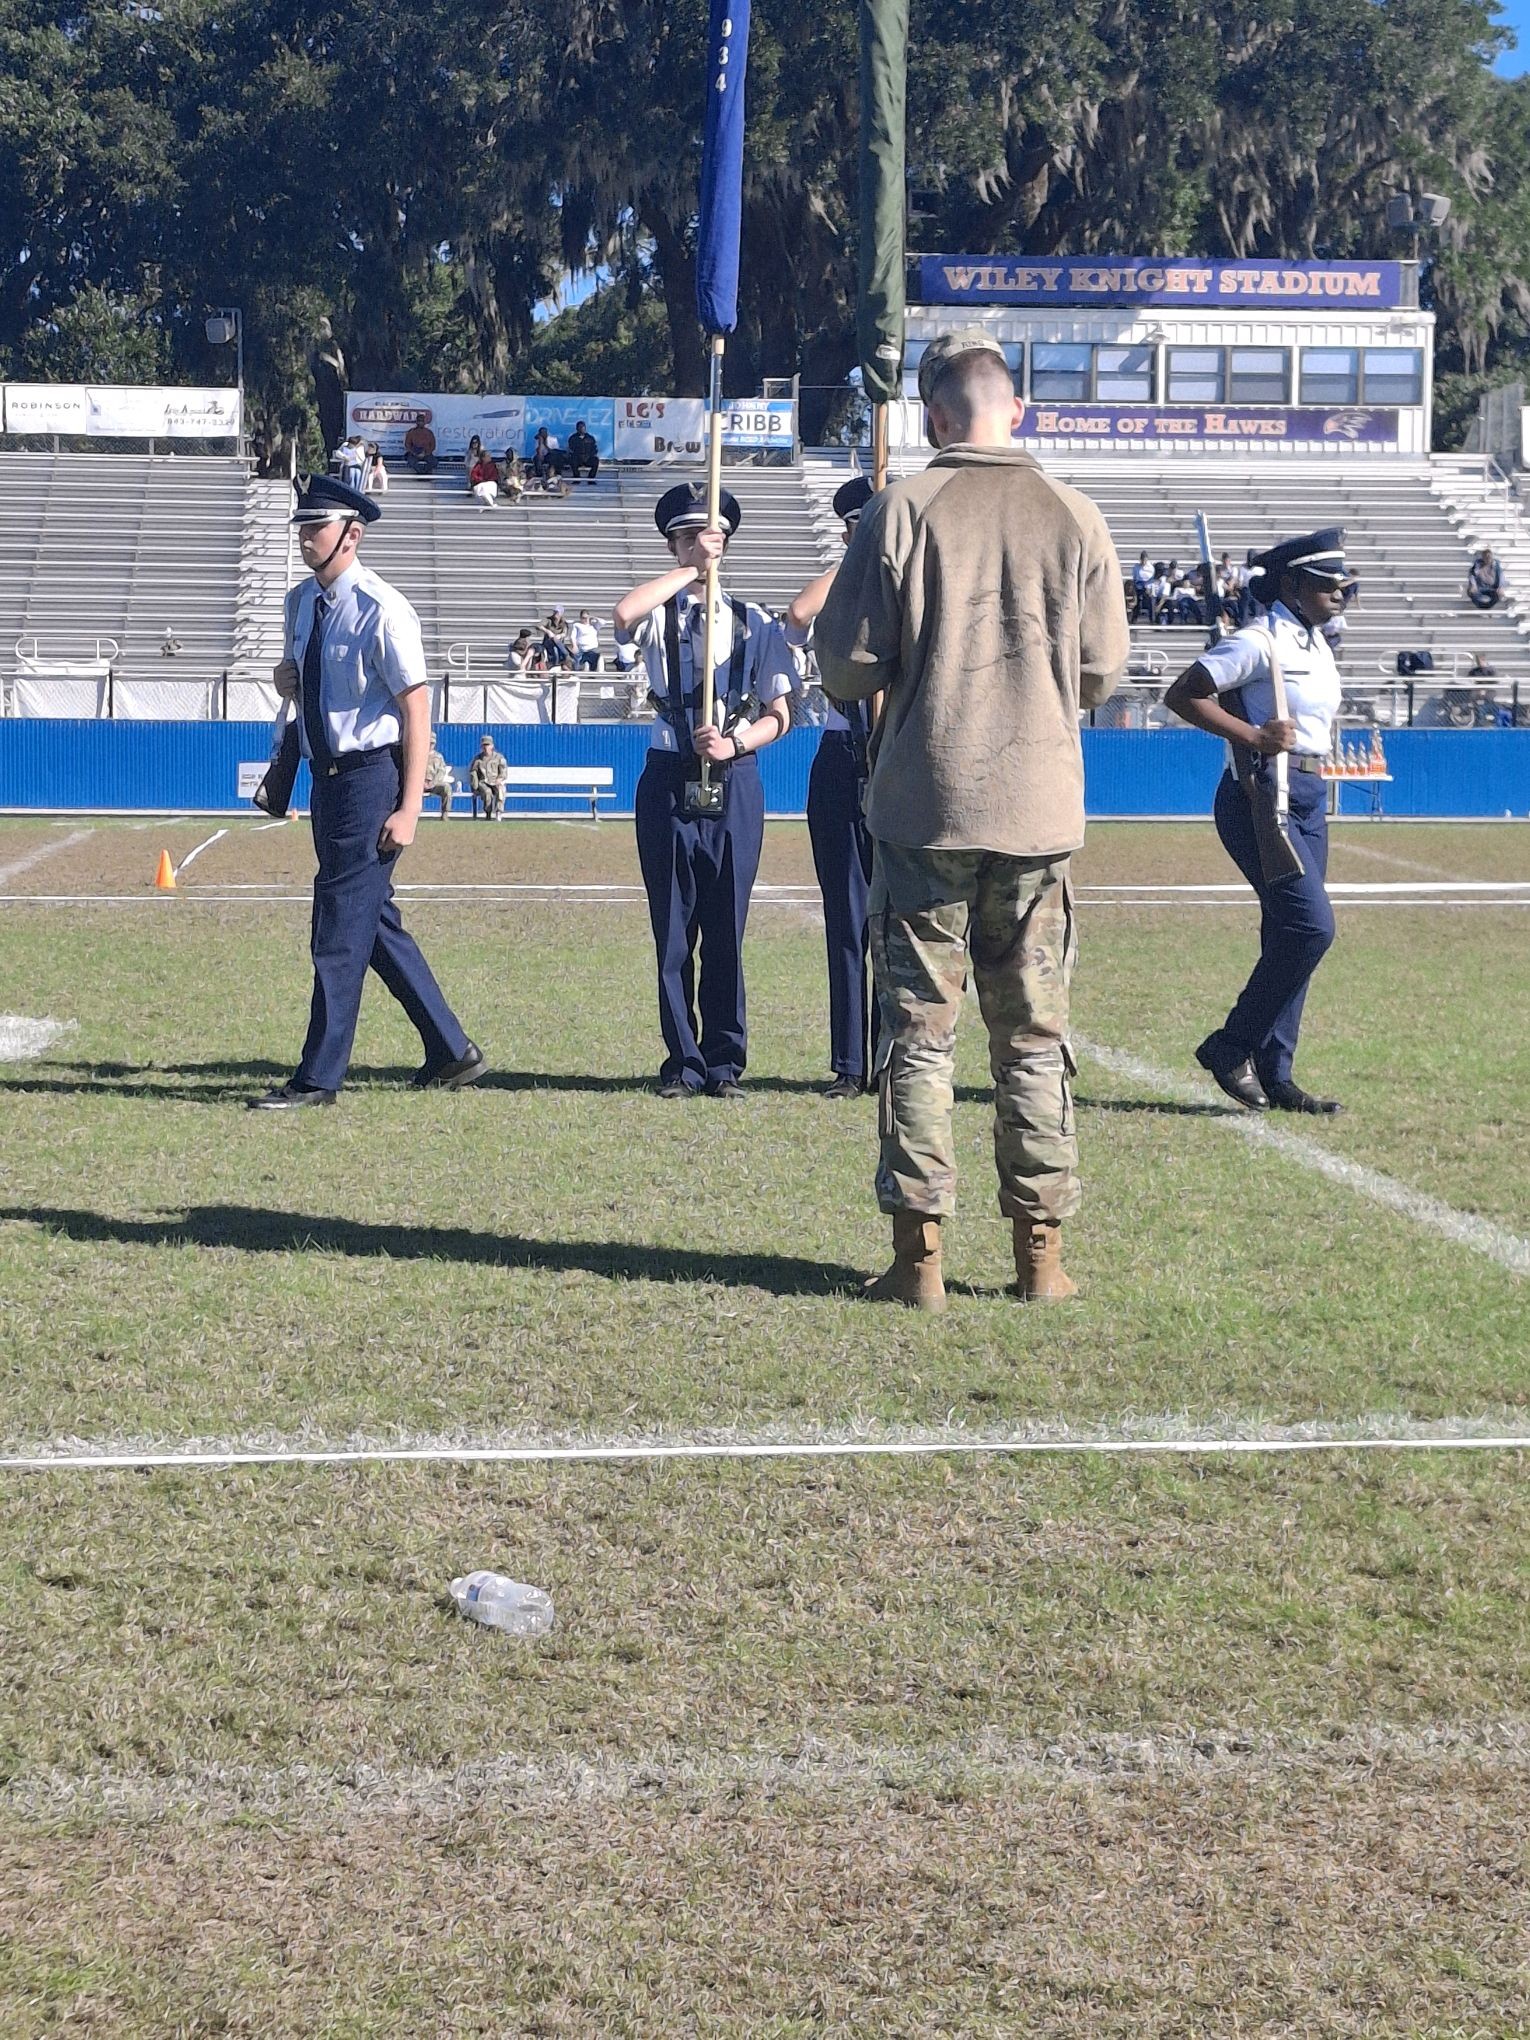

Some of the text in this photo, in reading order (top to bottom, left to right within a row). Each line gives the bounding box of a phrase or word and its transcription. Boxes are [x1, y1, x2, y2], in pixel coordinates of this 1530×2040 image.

[943, 266, 1382, 296] WILEY KNIGHT STADIUM
[11, 401, 81, 410] ROBINSON
[437, 424, 526, 441] restoration
